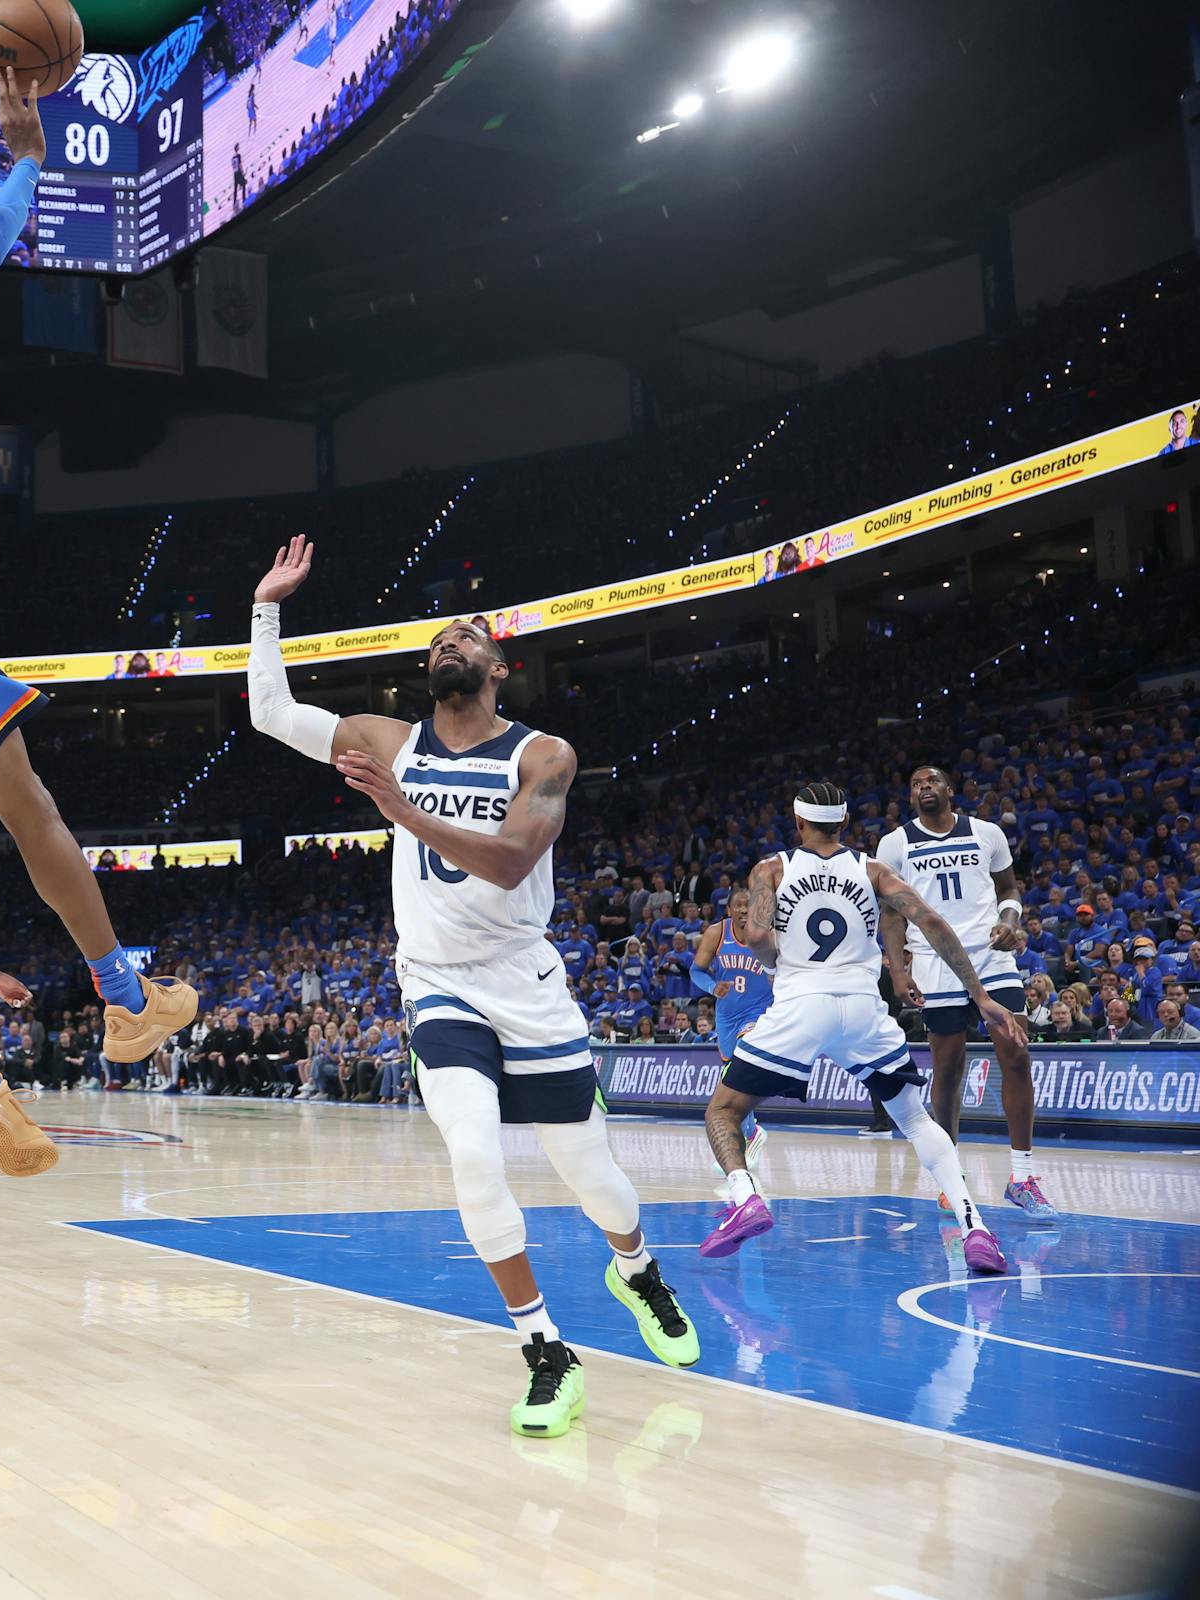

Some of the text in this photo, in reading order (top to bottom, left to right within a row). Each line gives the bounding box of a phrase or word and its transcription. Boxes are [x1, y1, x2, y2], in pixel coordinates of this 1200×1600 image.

[158, 97, 184, 153] 97
[65, 122, 110, 166] 80
[39, 171, 136, 187] PLAYER PTS FL
[38, 185, 134, 200] MCDANIELS 17 2
[38, 200, 134, 215] ALEXANDER-WALKER 11 2
[38, 214, 65, 225] CONLEY
[130, 221, 134, 229] 1
[38, 229, 55, 239] REID
[55, 259, 61, 268] 2
[78, 261, 82, 269] 1
[129, 249, 135, 258] 2
[864, 447, 1097, 534] Cooling Plumbing Generators
[550, 562, 755, 615] Cooling Plumbing Generators
[214, 651, 250, 663] Coolin
[281, 640, 321, 656] umbing
[334, 630, 400, 648] Generators
[4, 661, 65, 674] Generators
[402, 791, 508, 822] WOLVES
[913, 854, 979, 872] WOLVES
[937, 872, 962, 900] 11
[775, 874, 875, 937] ALEXANDER-WALKER
[806, 908, 848, 962] 9
[719, 954, 764, 975] THUNDER
[735, 976, 746, 993] 8
[608, 1057, 722, 1097] NBATickets.co
[1031, 1060, 1200, 1113] BATickets.co
